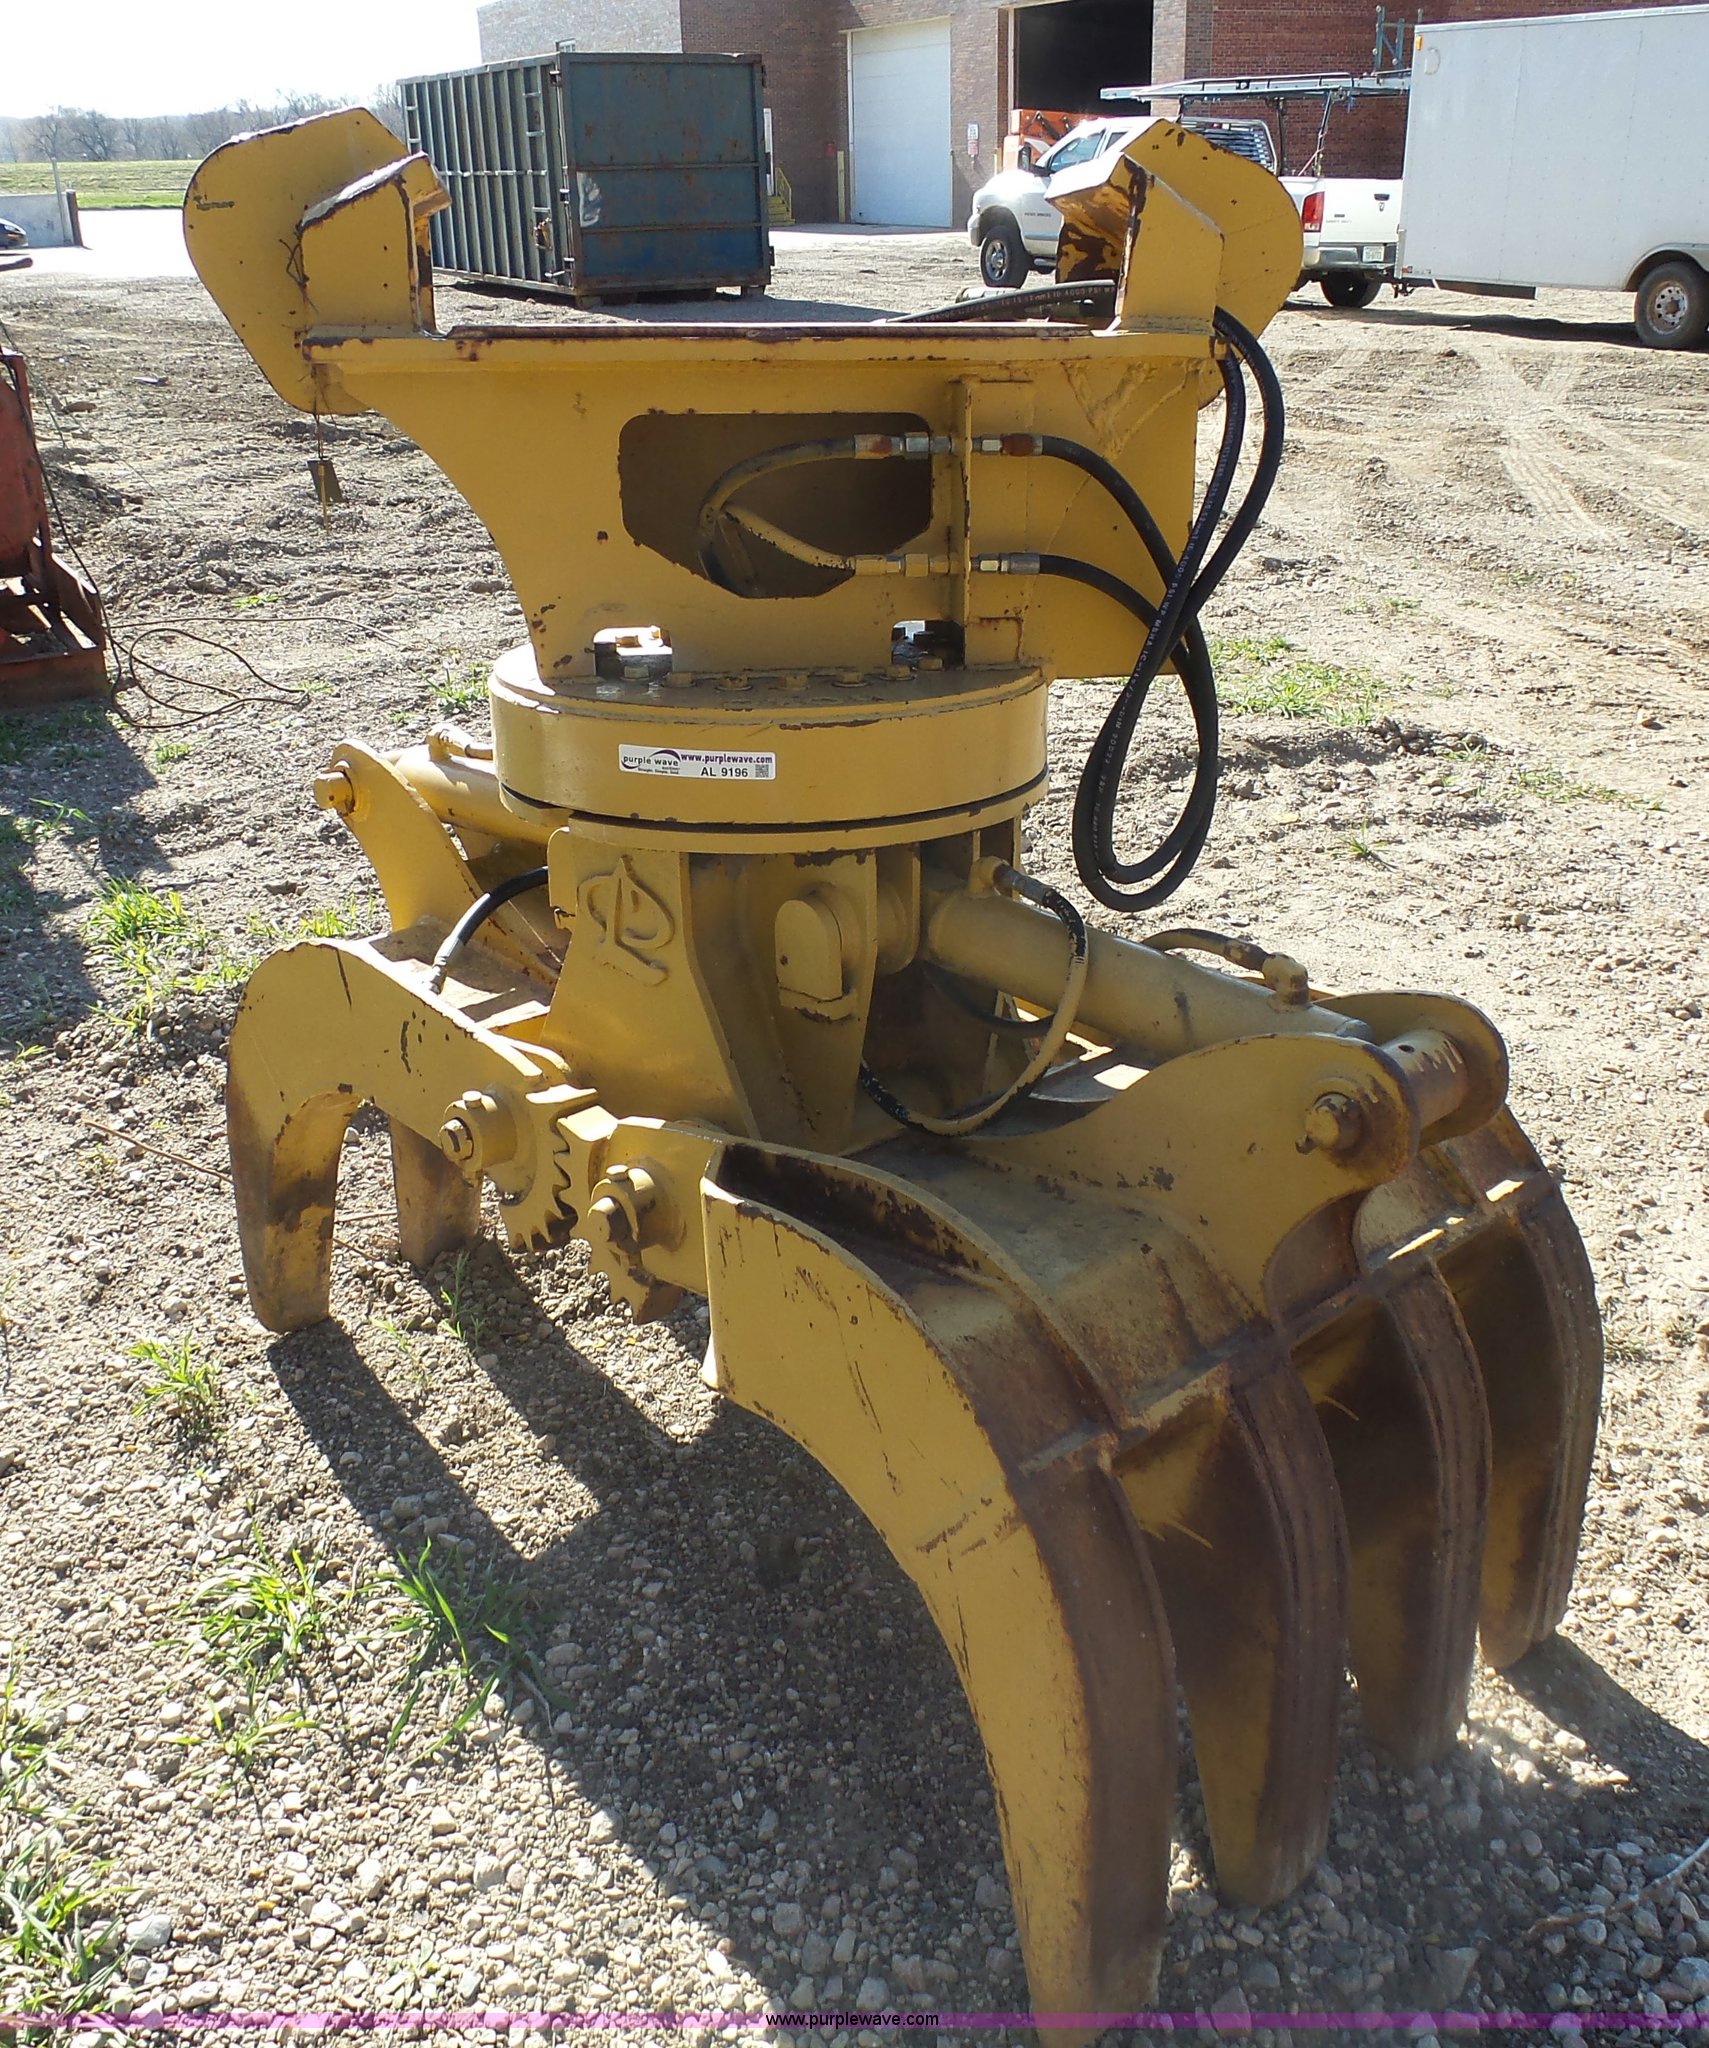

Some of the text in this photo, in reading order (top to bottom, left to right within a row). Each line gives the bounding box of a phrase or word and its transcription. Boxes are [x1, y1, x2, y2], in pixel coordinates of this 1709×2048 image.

[623, 756, 679, 767] purple wave
[681, 754, 772, 765] www.purplewave.com
[701, 767, 748, 777] AL 9196
